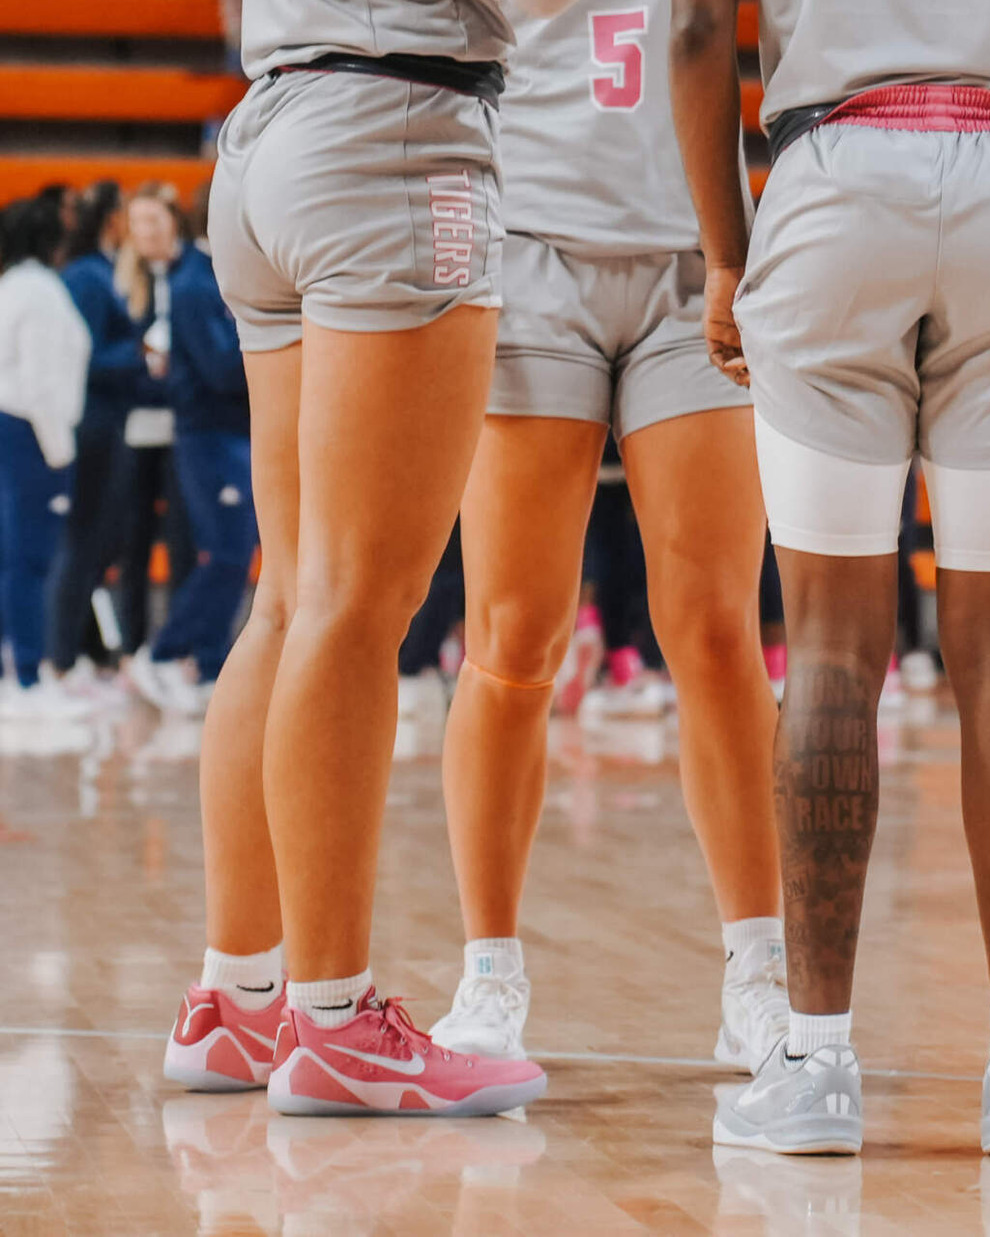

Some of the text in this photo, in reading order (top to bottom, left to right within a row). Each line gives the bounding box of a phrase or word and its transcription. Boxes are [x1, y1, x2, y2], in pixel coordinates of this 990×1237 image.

[588, 7, 648, 112] 5
[425, 169, 475, 288] TIGERS
[796, 795, 864, 832] RACE
